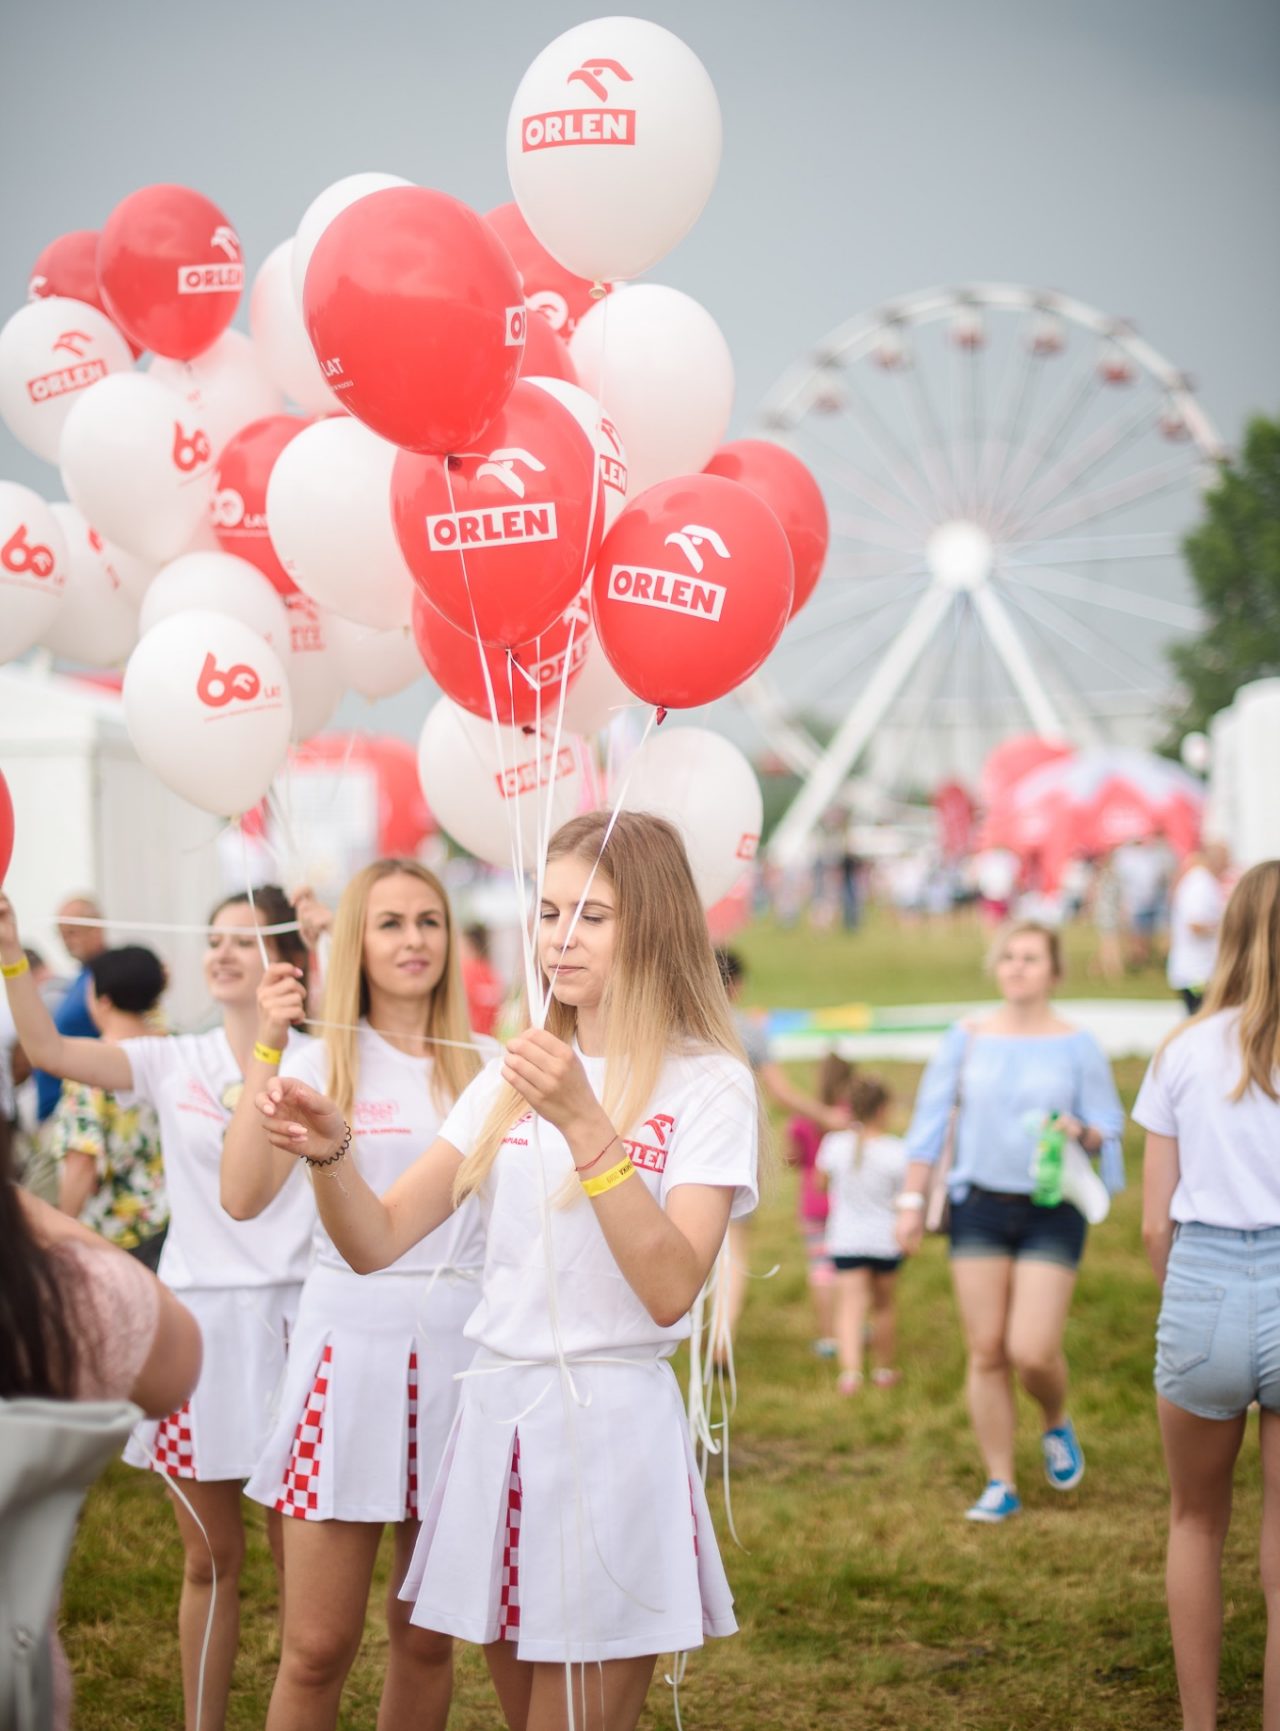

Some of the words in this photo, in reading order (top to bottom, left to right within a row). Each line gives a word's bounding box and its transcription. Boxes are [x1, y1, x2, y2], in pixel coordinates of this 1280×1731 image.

[525, 113, 628, 146] ORLEN
[320, 357, 344, 377] LAT
[600, 458, 626, 492] LEN
[433, 508, 550, 546] ORLEN
[1, 524, 55, 578] 60
[613, 570, 717, 615] ORLEN
[538, 638, 590, 682] ORLE
[197, 651, 260, 708] 60
[623, 1143, 665, 1168] RLE
